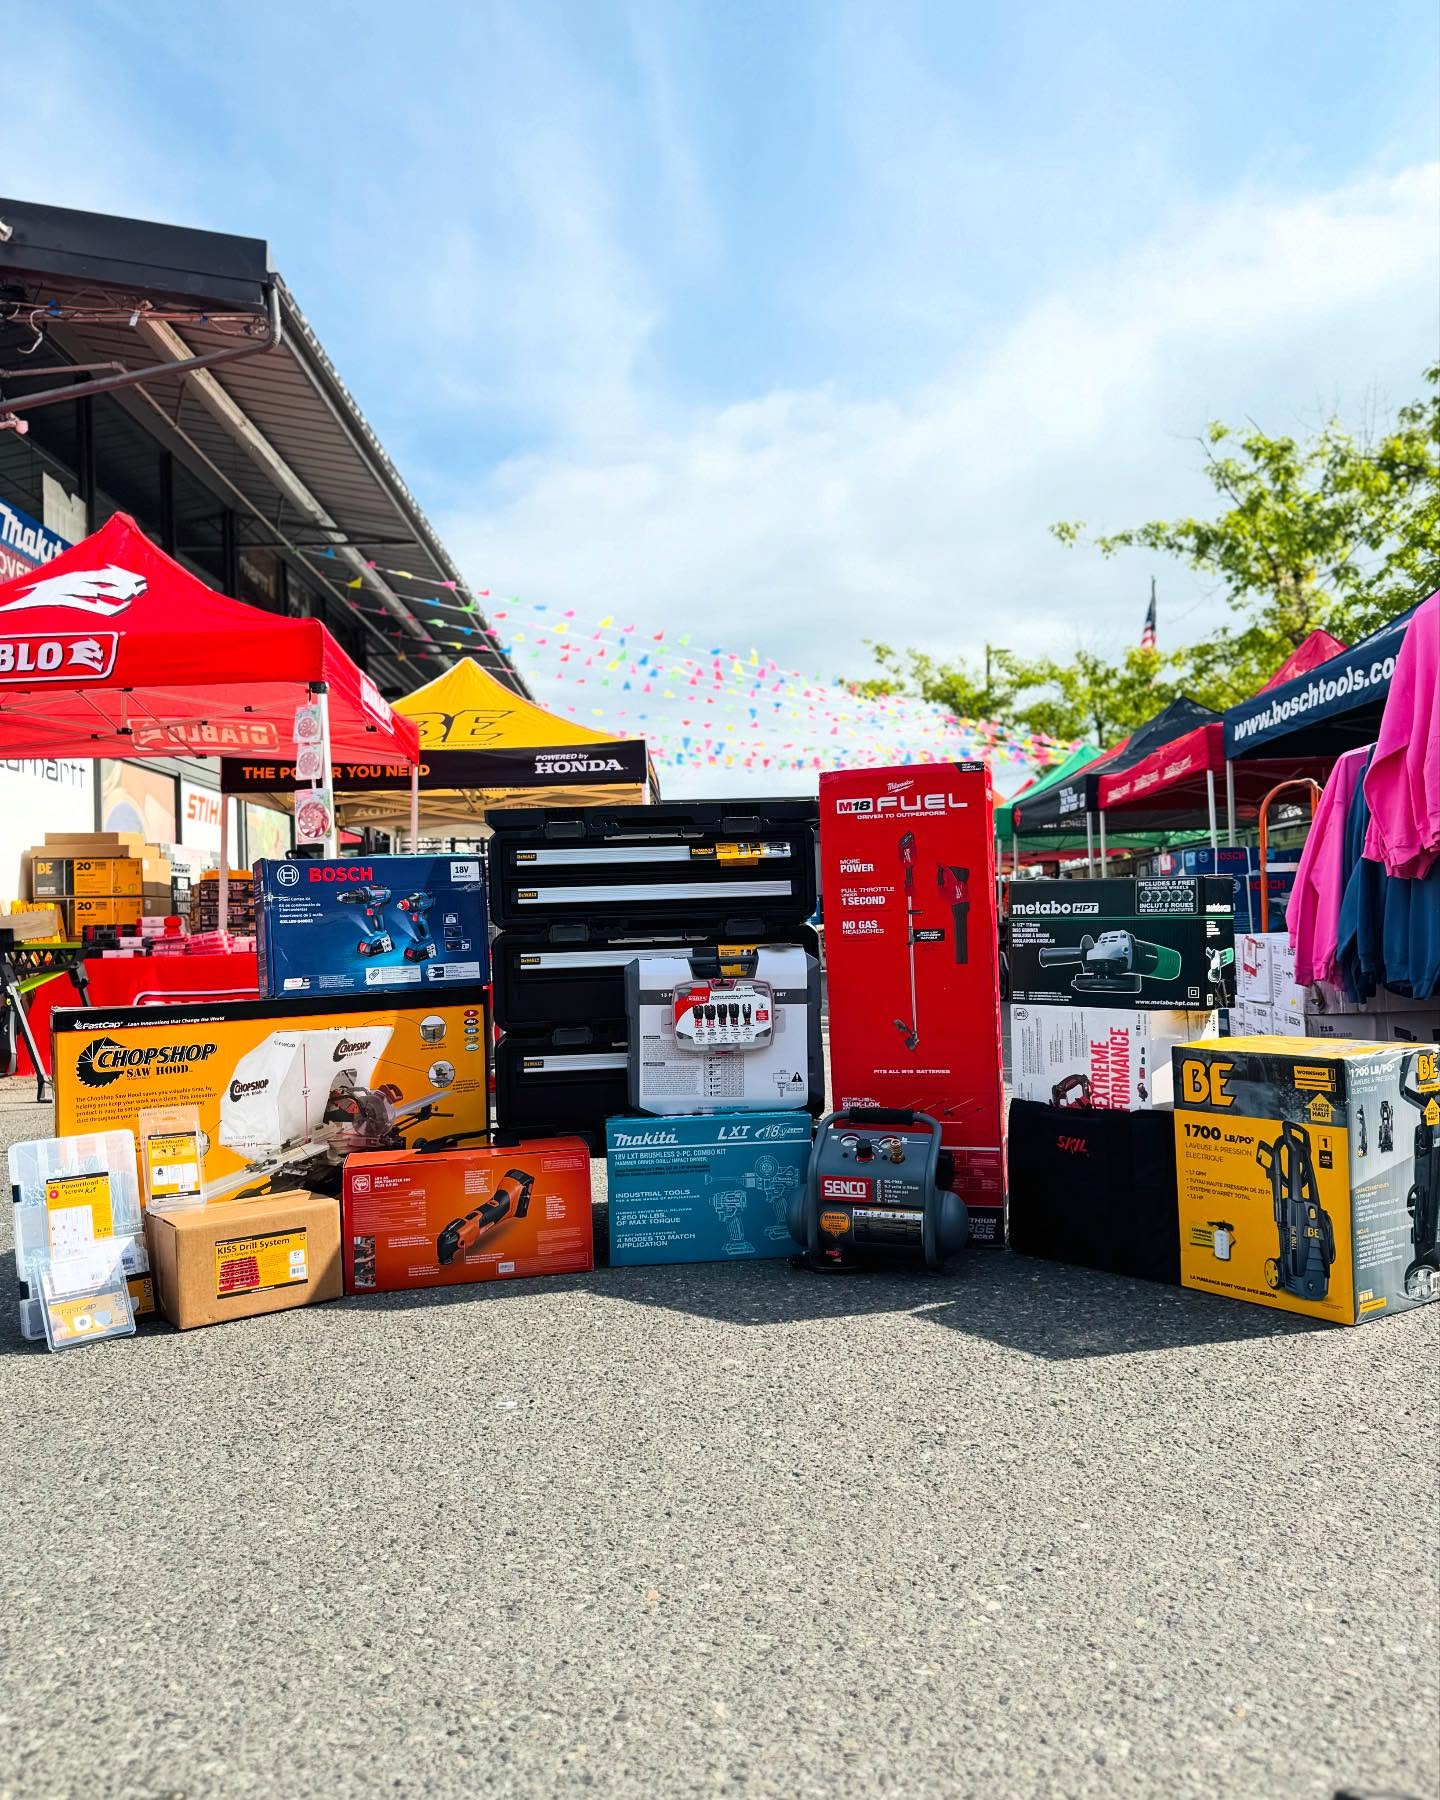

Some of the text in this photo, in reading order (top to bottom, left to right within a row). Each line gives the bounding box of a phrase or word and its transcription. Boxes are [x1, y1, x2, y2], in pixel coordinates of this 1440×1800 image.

[0, 503, 64, 563] Makit
[1234, 655, 1399, 741] www.boschtools.co
[535, 752, 589, 761] POWERED by
[243, 767, 275, 779] THE
[280, 766, 342, 779] POR
[347, 765, 383, 778] YOU
[535, 759, 624, 774] HONDA
[838, 792, 968, 812] M18 FUEL
[309, 866, 373, 883] BOSCH
[454, 865, 469, 874] 18V
[840, 864, 874, 873] POWER
[848, 896, 886, 905] SECOND
[1012, 900, 1099, 914] metabo HPT
[842, 920, 878, 930] NO GAS
[1135, 999, 1200, 1007] www.metabo-hpt.com
[83, 1021, 121, 1029] FastCap
[97, 1043, 218, 1069] CHOPSHOP
[126, 1065, 189, 1078] SAW HOOD
[1418, 1053, 1439, 1081] BE
[1090, 1040, 1110, 1110] EXTREME
[235, 1079, 269, 1094] CHOPSHOP
[1180, 1058, 1237, 1108] BE
[1312, 1110, 1330, 1118] HAUT
[717, 1125, 750, 1140] LXT
[1184, 1123, 1222, 1141] 1700
[1056, 1135, 1088, 1153] SKIL
[1185, 1142, 1253, 1157] LAVEUSE PRESSION
[640, 1151, 675, 1159] BRUSHLESS
[824, 1180, 867, 1195] SENCO
[615, 1191, 662, 1199] INDUSTRIAL
[624, 1235, 653, 1243] MODES
[1307, 1227, 1320, 1239] BE
[217, 1237, 290, 1255] KISS Drill System
[616, 1240, 668, 1249] APPLICATION
[1220, 1280, 1233, 1289] DONT
[1234, 1283, 1247, 1292] VOUS
